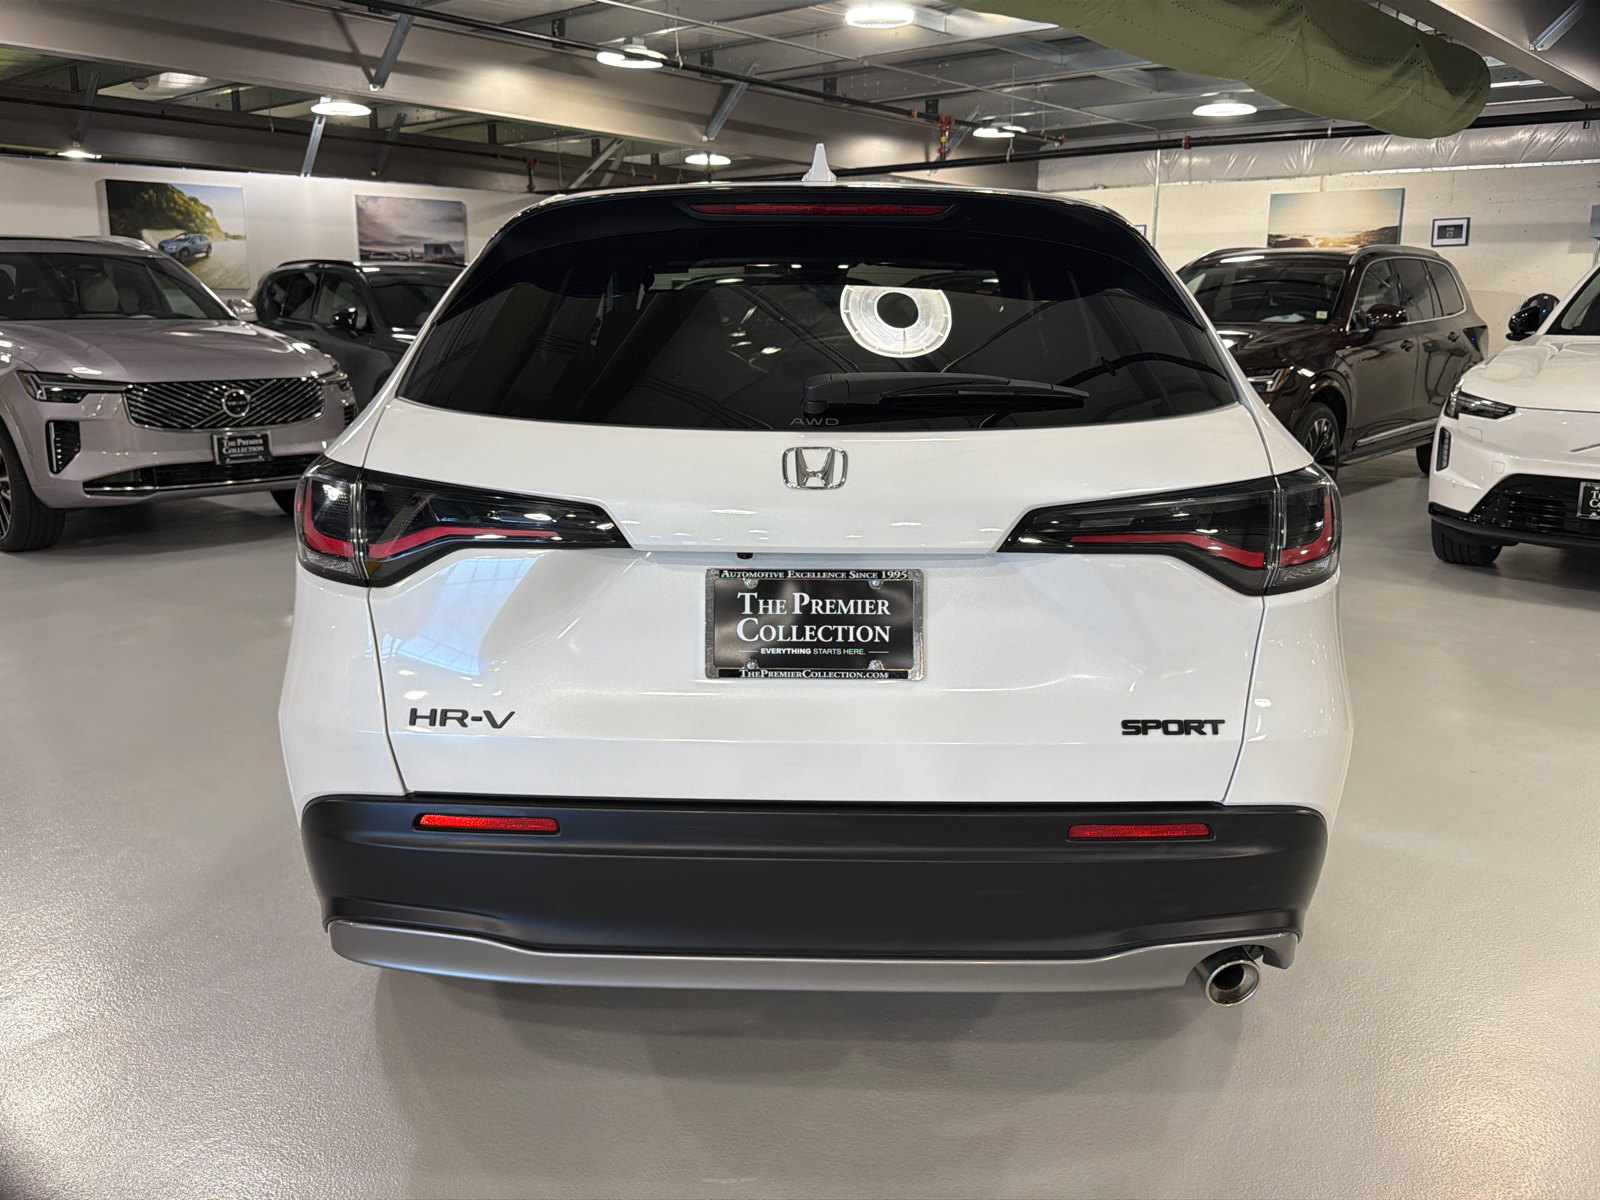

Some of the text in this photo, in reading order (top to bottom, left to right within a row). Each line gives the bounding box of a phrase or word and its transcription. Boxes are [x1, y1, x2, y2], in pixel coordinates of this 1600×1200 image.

[789, 417, 839, 426] AWD
[721, 570, 908, 580] AUTOMOTIVE EXCELLENCE SINCE 1995
[737, 592, 892, 616] THE PREMIER
[736, 617, 892, 643] COLLECTION
[760, 647, 866, 656] EVERYTHING STARTS HERE.
[739, 669, 889, 680] THEPREMIERCOLLECTION.COM
[408, 707, 516, 729] HR-V
[1121, 719, 1225, 735] SPORT
